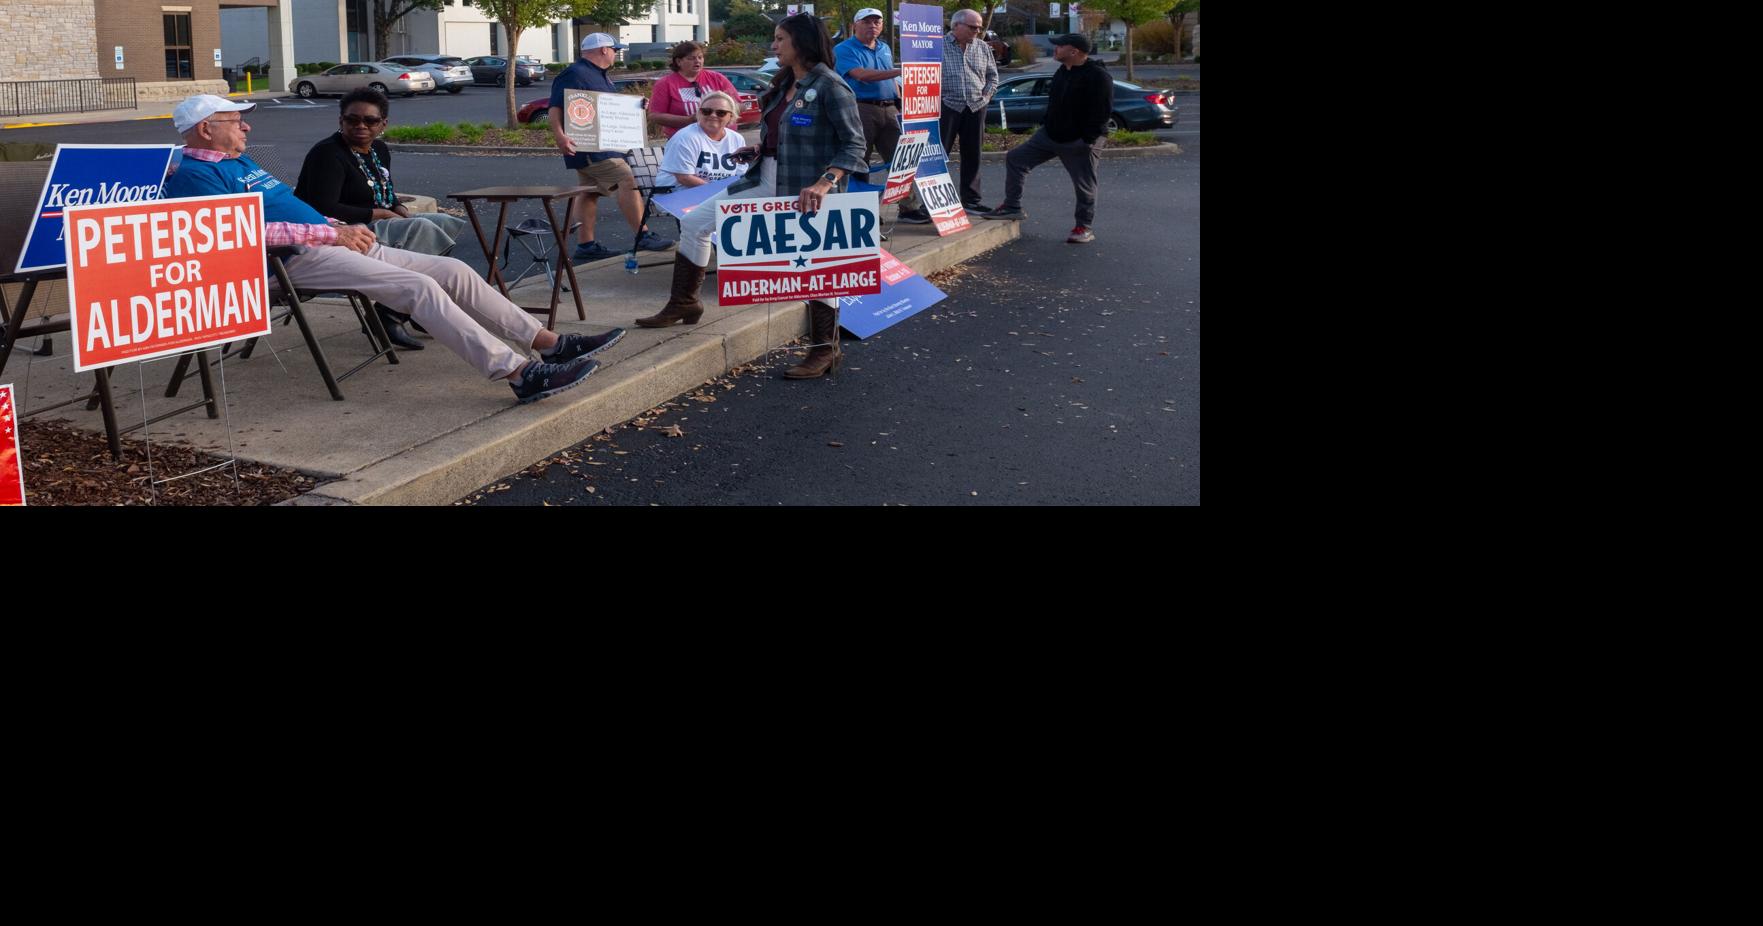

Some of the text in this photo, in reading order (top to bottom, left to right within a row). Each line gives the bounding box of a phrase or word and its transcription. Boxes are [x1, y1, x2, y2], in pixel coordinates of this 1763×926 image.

[902, 20, 942, 33] Ken Moore
[912, 40, 934, 48] MAYOR
[904, 66, 940, 84] PETERSEN
[916, 86, 928, 95] FOR
[905, 96, 939, 115] ALDERMAN
[892, 142, 924, 173] CAESAR
[45, 182, 158, 208] Ken Moore
[922, 183, 959, 210] CAESAR
[720, 203, 757, 214] VOTE
[77, 204, 257, 267] PETERSEN
[720, 208, 875, 257] CAESAR
[150, 260, 202, 288] FOR
[723, 271, 877, 298] ALDERMAN-AT-LARGE
[86, 278, 262, 352] ALDERMAN
